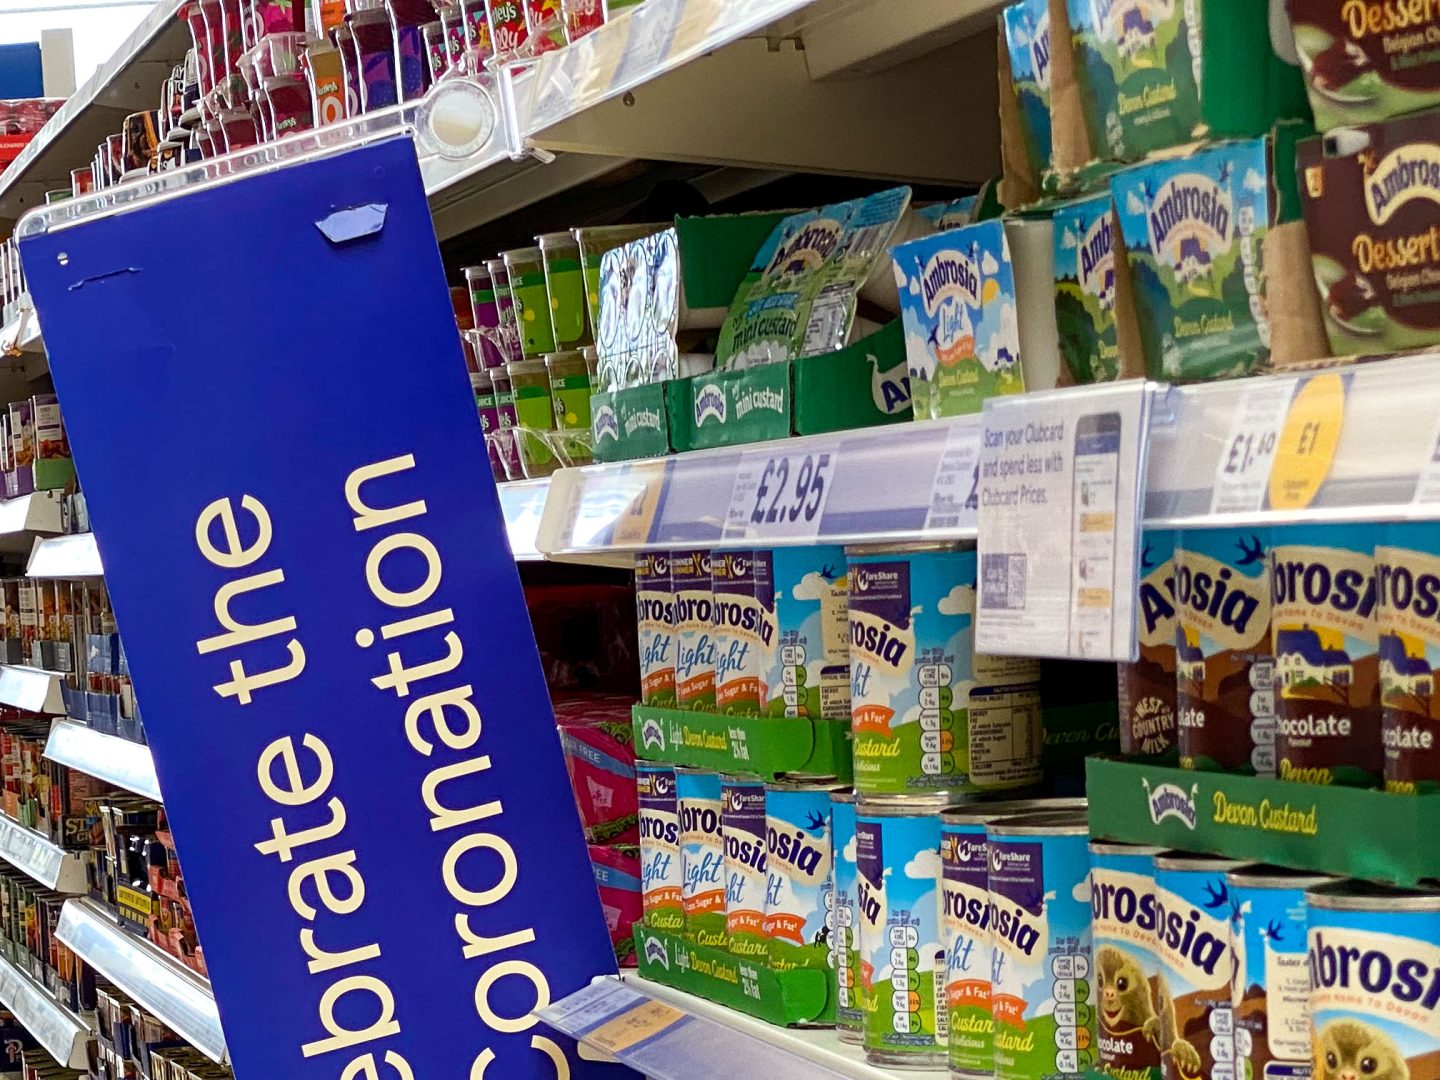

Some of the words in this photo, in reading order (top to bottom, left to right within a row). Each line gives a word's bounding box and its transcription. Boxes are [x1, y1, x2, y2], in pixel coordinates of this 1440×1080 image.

[1370, 153, 1440, 217] Ambros
[1149, 184, 1231, 248] Ambrosia
[1352, 226, 1440, 273] Dessert
[923, 256, 978, 311] Ambrosia
[758, 311, 801, 338] custard
[696, 391, 724, 423] Ambrosia
[735, 387, 753, 420] mini
[753, 386, 783, 414] custard
[984, 428, 1003, 448] Scan
[1005, 427, 1023, 450] your
[1025, 419, 1064, 444] Clubcard
[1296, 421, 1320, 455] £1
[983, 458, 998, 477] and
[999, 457, 1025, 481] spend
[1027, 456, 1043, 474] less
[1045, 455, 1063, 473] with
[750, 453, 831, 526] £2.95
[982, 486, 1019, 506] Clubcard
[866, 571, 898, 580] FareShare
[195, 494, 307, 705] the
[676, 634, 717, 678] Light
[1132, 712, 1175, 739] COUNTRY
[1280, 757, 1336, 787] Devon
[1153, 789, 1198, 826] Ambrosia
[1213, 791, 1259, 828] Devon
[1259, 799, 1319, 837] Custard
[683, 853, 724, 894] Light
[951, 1012, 994, 1032] Custar
